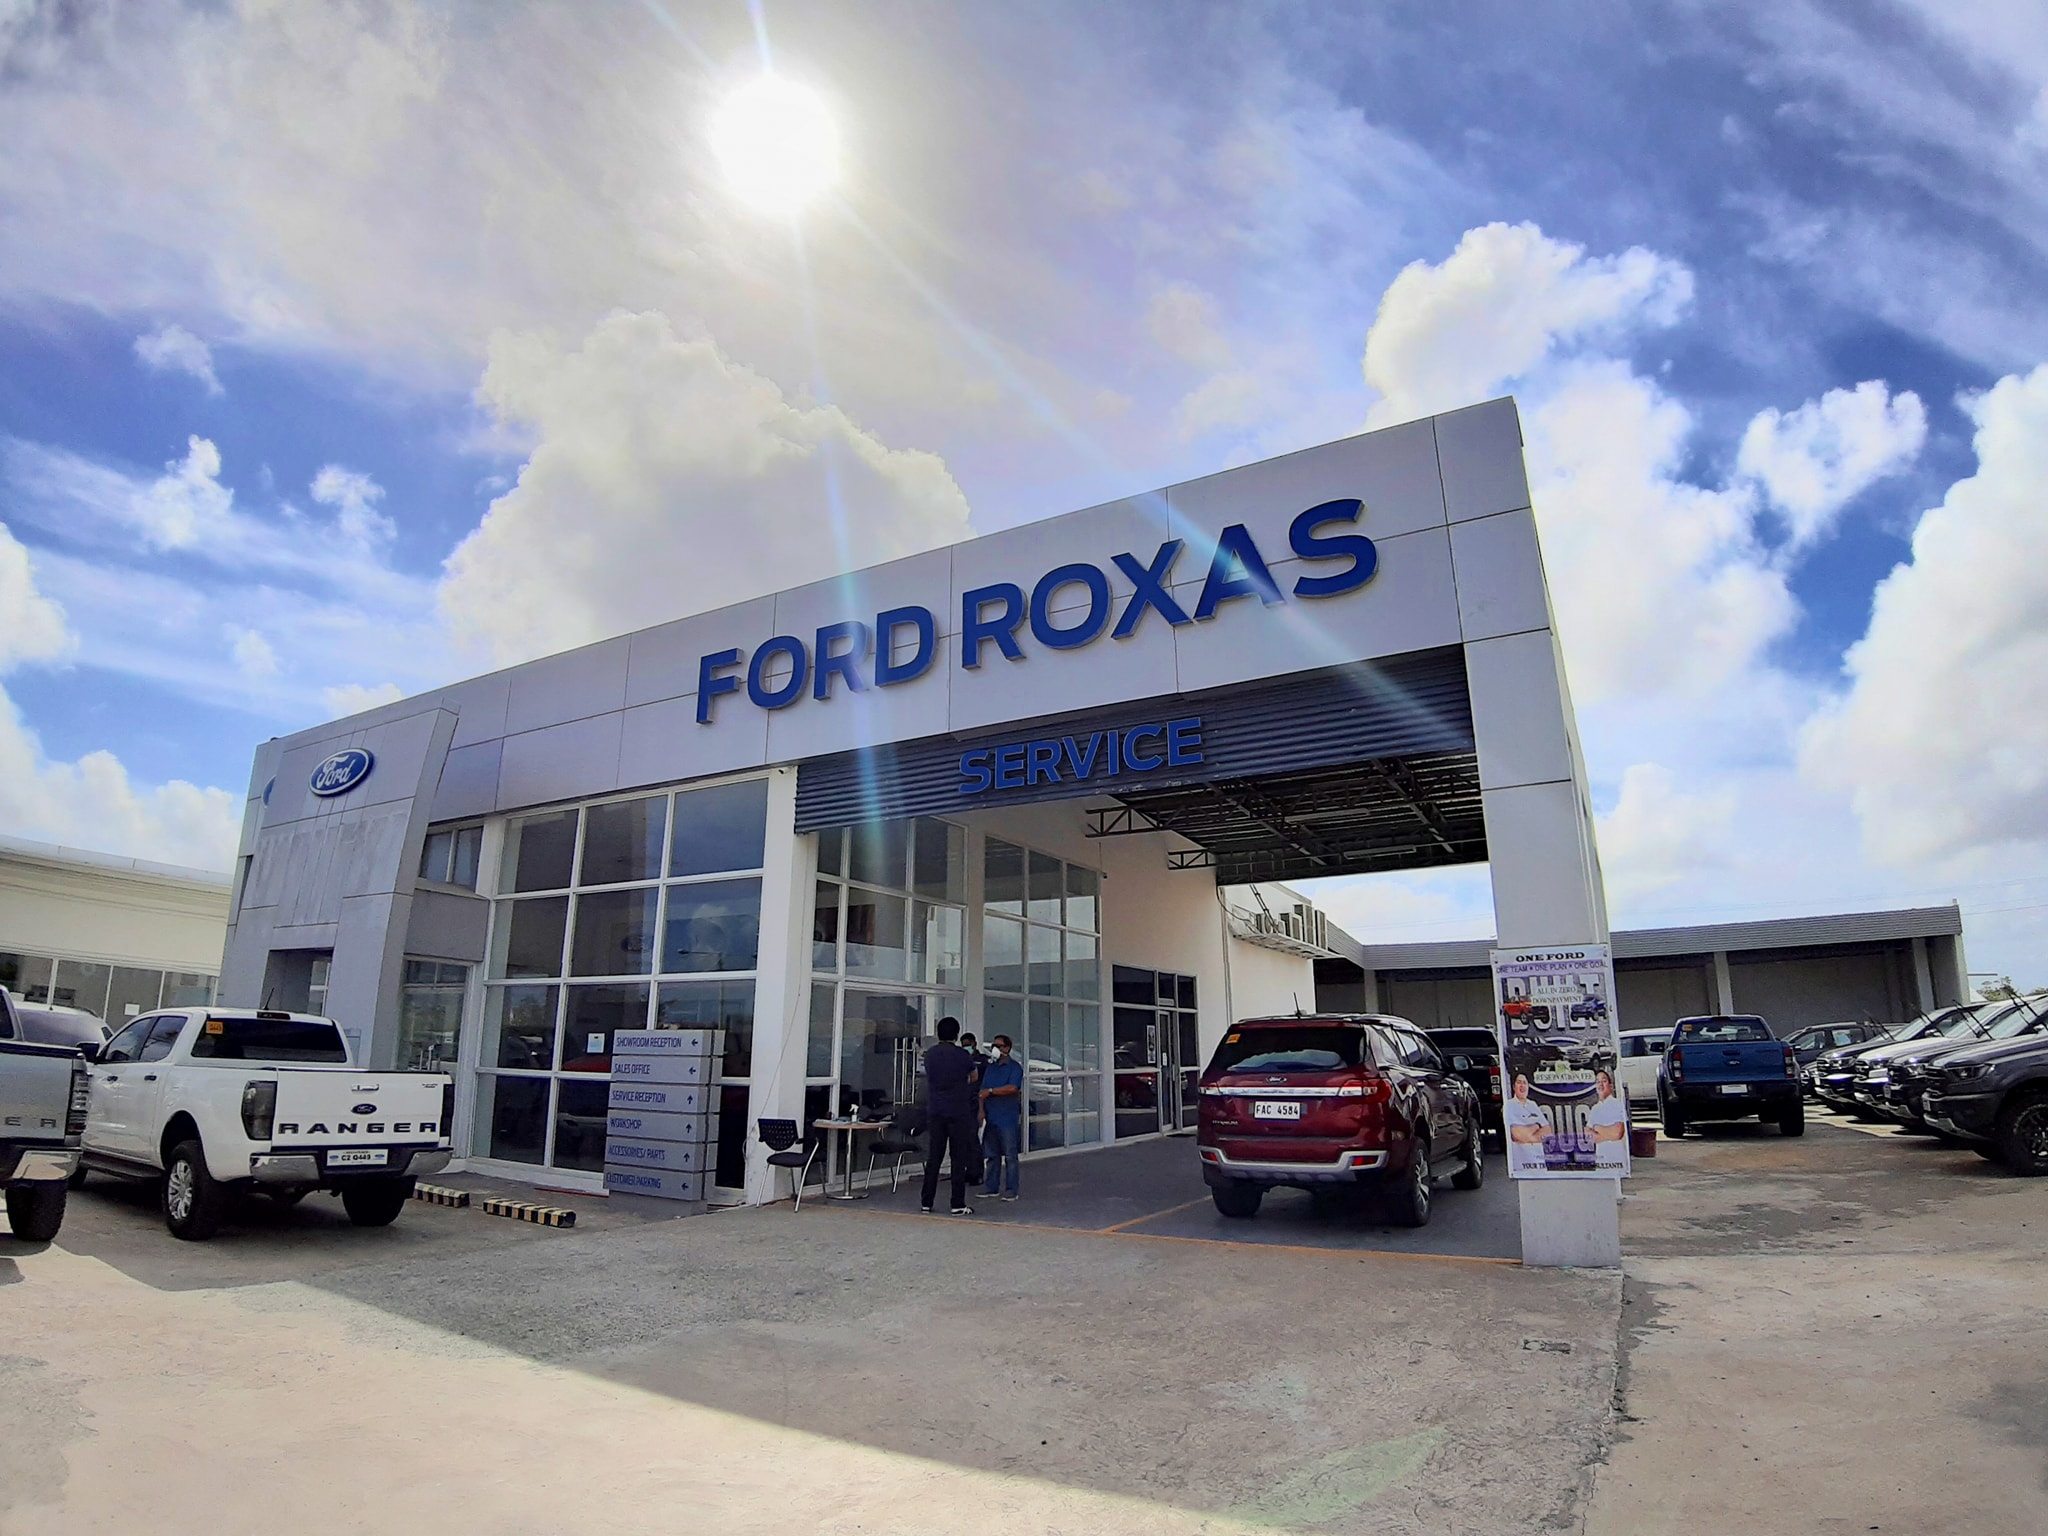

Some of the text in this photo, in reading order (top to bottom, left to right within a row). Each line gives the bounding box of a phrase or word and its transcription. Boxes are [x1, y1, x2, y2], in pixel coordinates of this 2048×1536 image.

[696, 499, 1380, 725] FORD ROXAS
[958, 716, 1204, 794] SERVICE
[316, 754, 357, 789] Ford
[1515, 951, 1585, 963] ONE FORD
[1535, 964, 1549, 972] ONE
[1550, 963, 1568, 971] PLAN
[1589, 960, 1608, 969] GOAL
[1533, 995, 1583, 1004] DOWNPAYMENT
[616, 1036, 681, 1048] SHOWROOM RECEPTION
[614, 1063, 650, 1074] SALES OFFICE
[612, 1090, 666, 1103] SERVICE RECEPTION
[1256, 1105, 1298, 1115] FAC 4584
[278, 1122, 437, 1134] RANGER
[610, 1118, 641, 1129] WORKSHOP
[647, 1149, 665, 1160] PARTS
[606, 1172, 661, 1189] CUSTOMER PARKING
